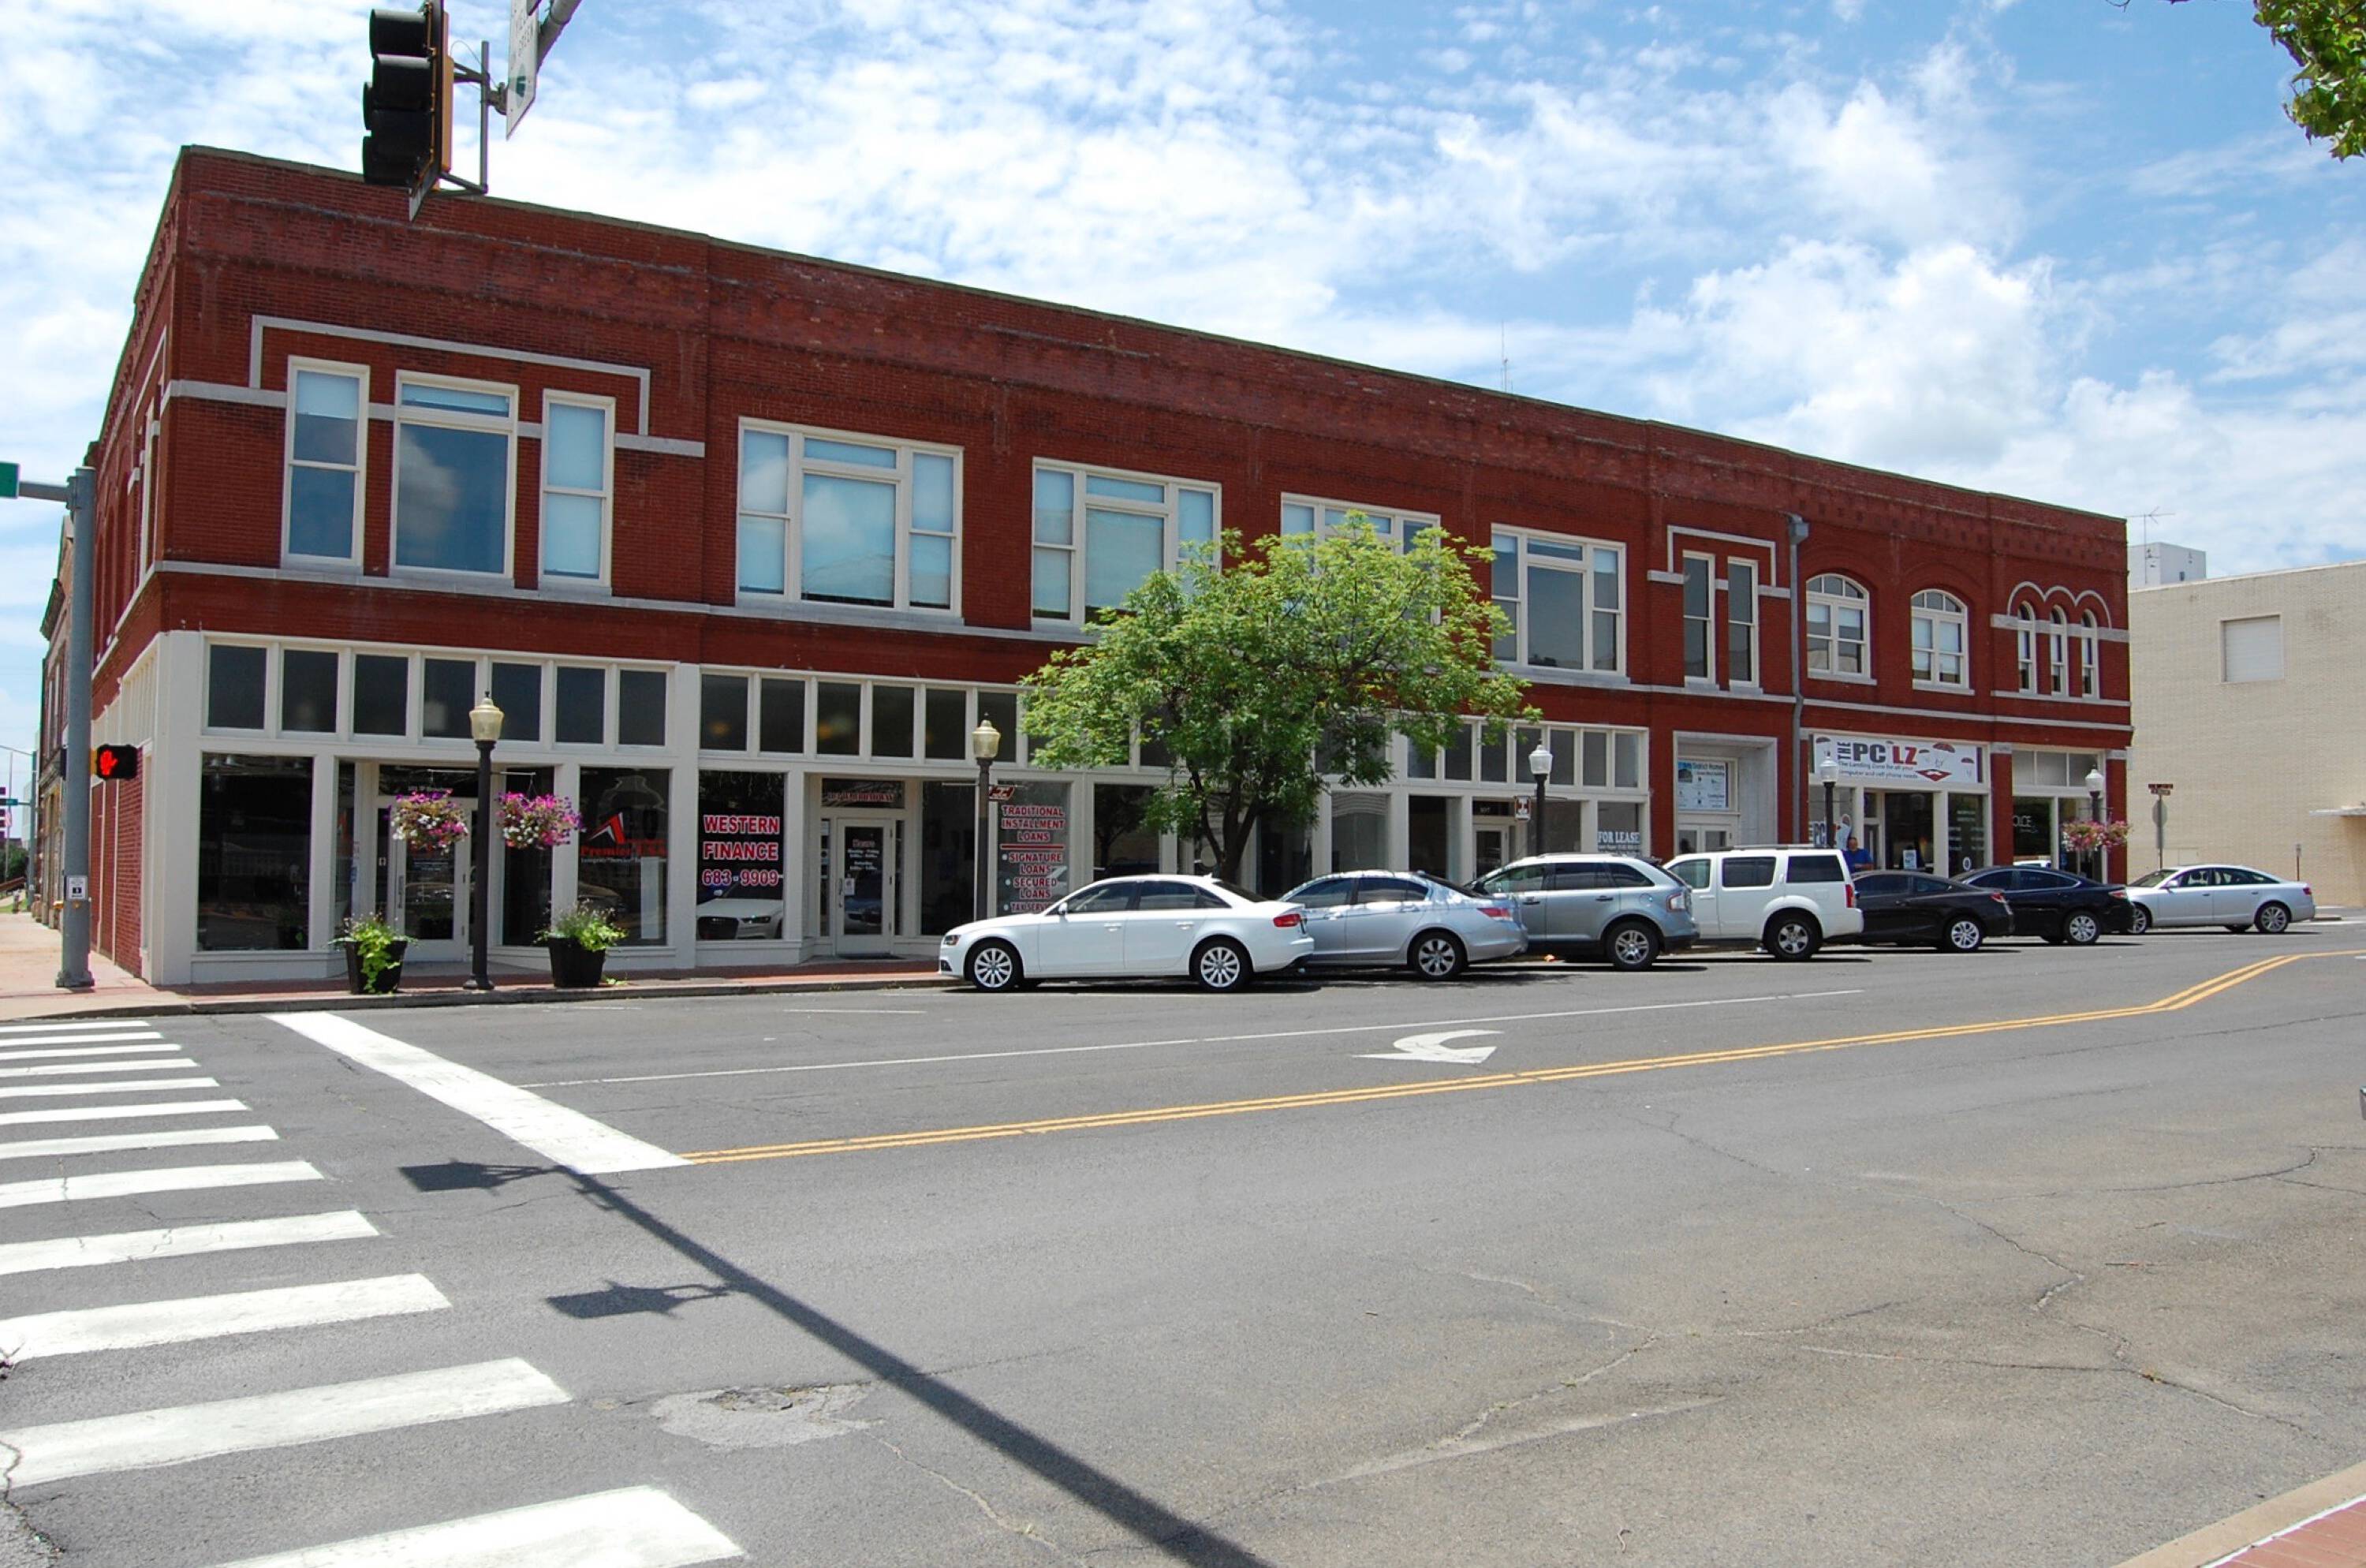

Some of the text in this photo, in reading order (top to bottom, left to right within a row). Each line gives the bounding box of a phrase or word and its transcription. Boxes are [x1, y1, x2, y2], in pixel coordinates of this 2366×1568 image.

[1838, 742, 1917, 764] THE PC LZ
[1002, 805, 1064, 817] TRADITIONAL
[703, 815, 780, 834] WESTERN
[1001, 818, 1065, 830] INSTALLMENT
[1017, 831, 1050, 842] LOANS
[1598, 831, 1640, 843] FOR LEASE
[703, 841, 778, 861] FINANCE
[1009, 853, 1063, 863] SIGNATURE
[1020, 864, 1052, 875] LOANS
[702, 868, 779, 886] 683-9909
[1013, 877, 1058, 887] SECURED
[1020, 889, 1052, 899] LOANS
